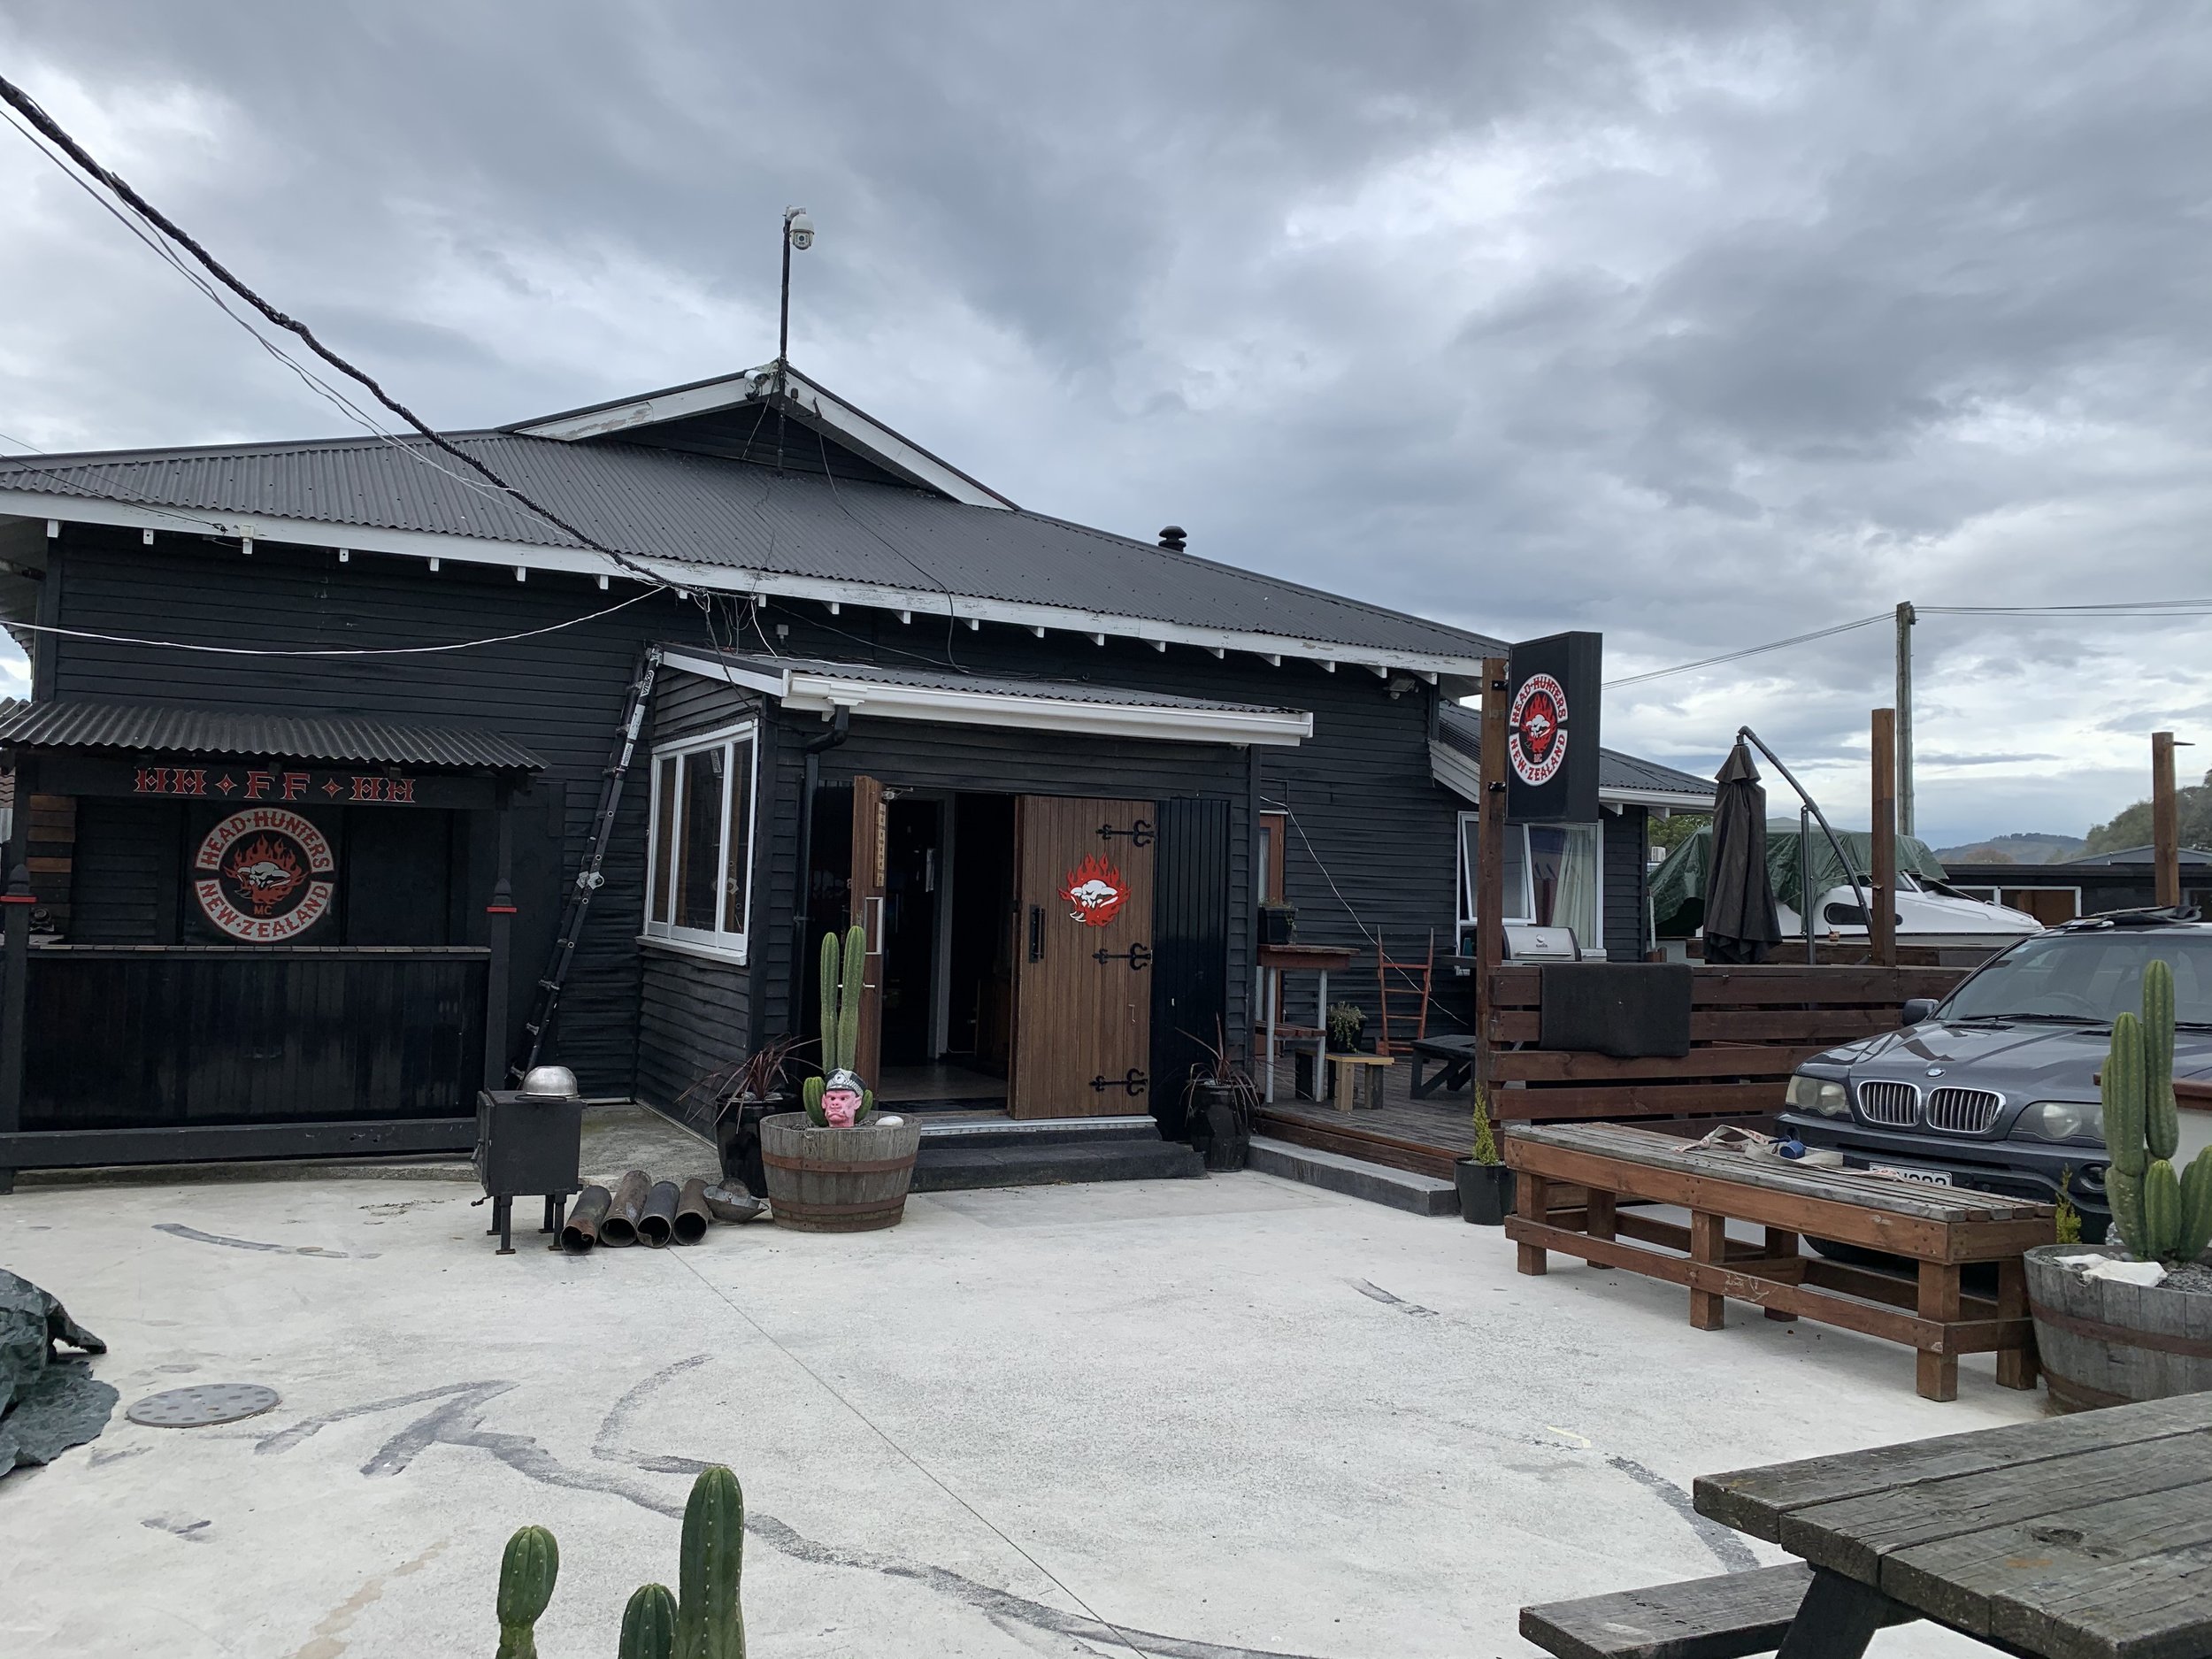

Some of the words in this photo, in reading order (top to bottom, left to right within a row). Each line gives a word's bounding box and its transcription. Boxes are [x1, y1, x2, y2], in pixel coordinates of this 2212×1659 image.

[1511, 683, 1532, 724] HEAD
[1532, 675, 1566, 718] HUNTERS
[1510, 738, 1527, 773] NEW
[1526, 733, 1565, 780] ZEALAND
[243, 771, 311, 800] FF
[200, 817, 247, 866] HEAD
[253, 810, 331, 869] HUNTERS
[199, 883, 240, 927] NEW
[238, 884, 329, 938] ZEALAND
[254, 905, 273, 916] MC
